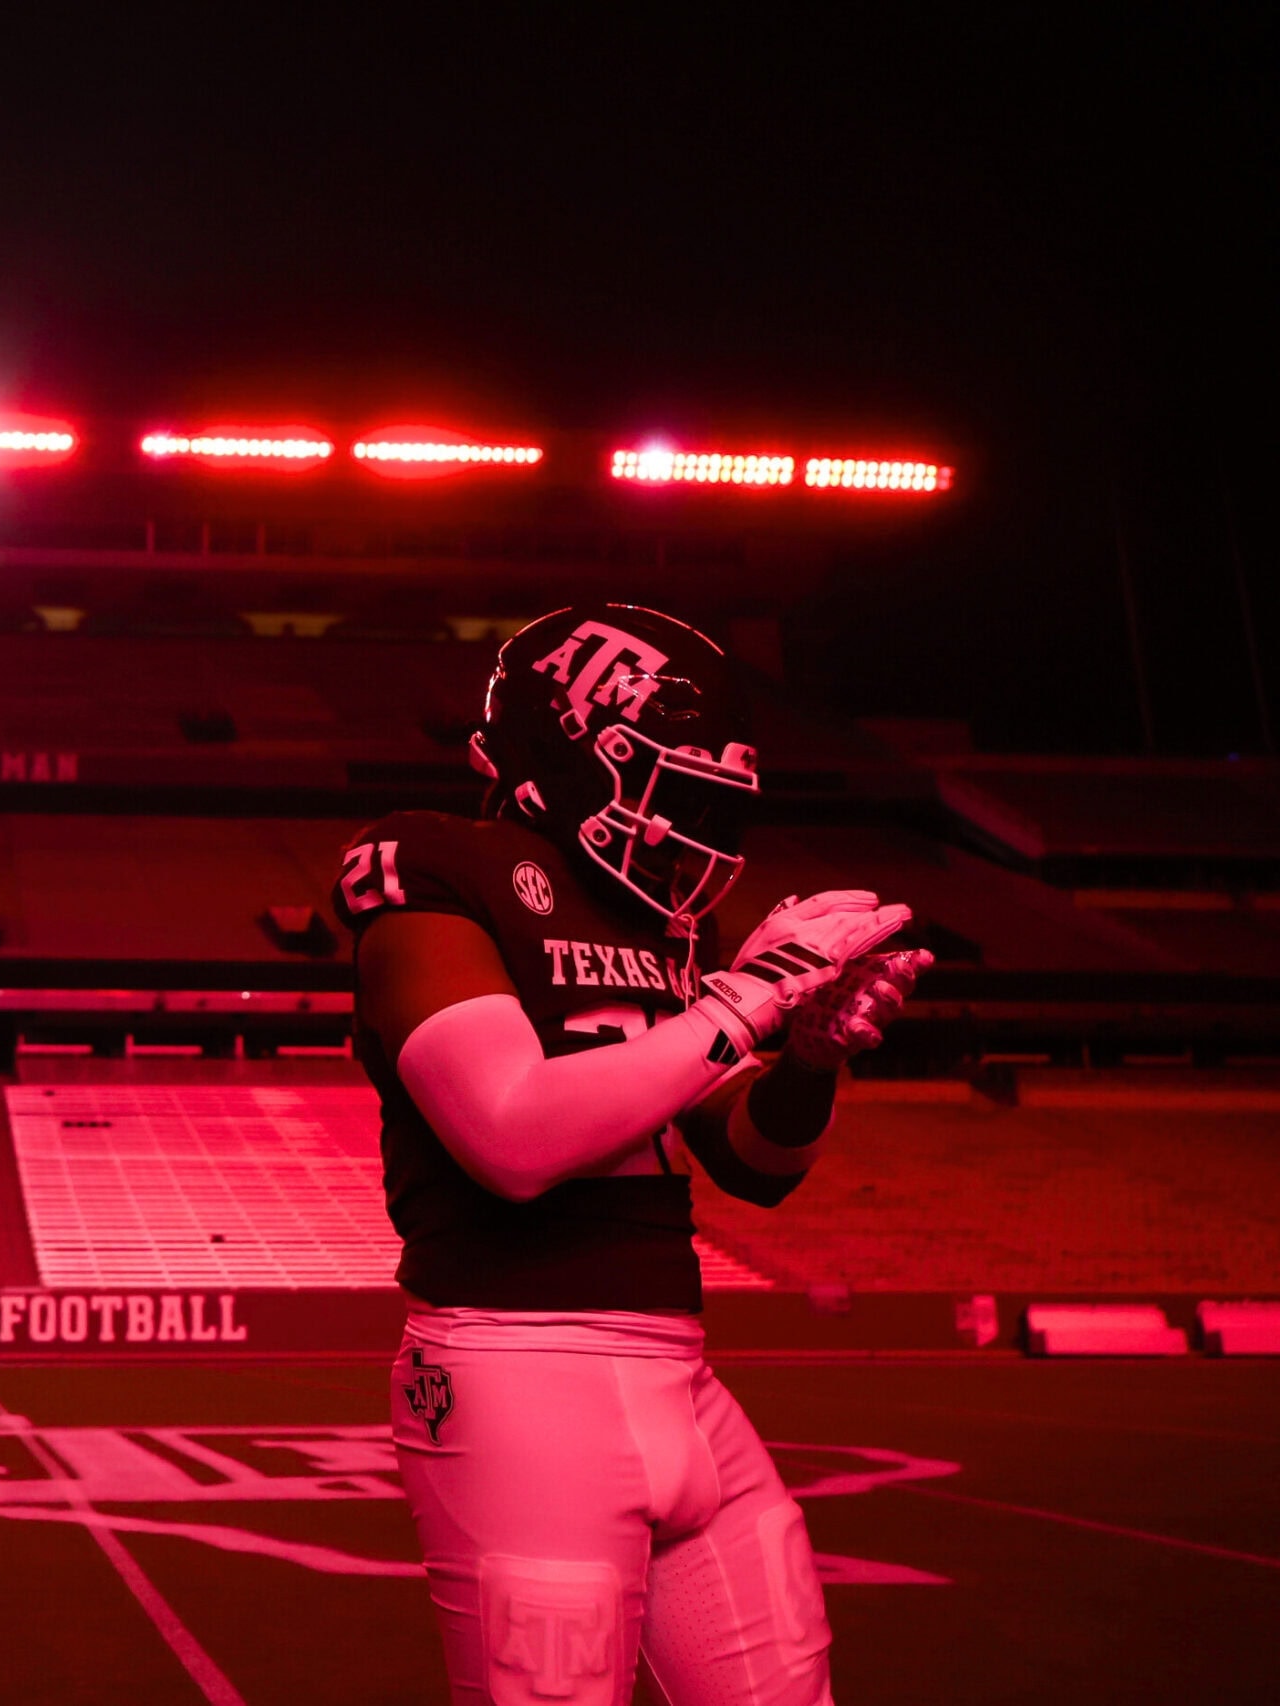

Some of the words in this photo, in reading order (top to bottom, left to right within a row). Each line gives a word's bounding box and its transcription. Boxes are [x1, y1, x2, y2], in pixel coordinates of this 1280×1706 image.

[0, 752, 79, 783] MAN
[340, 840, 407, 915] 21
[515, 865, 551, 911] SEC
[543, 938, 666, 991] TEXAS
